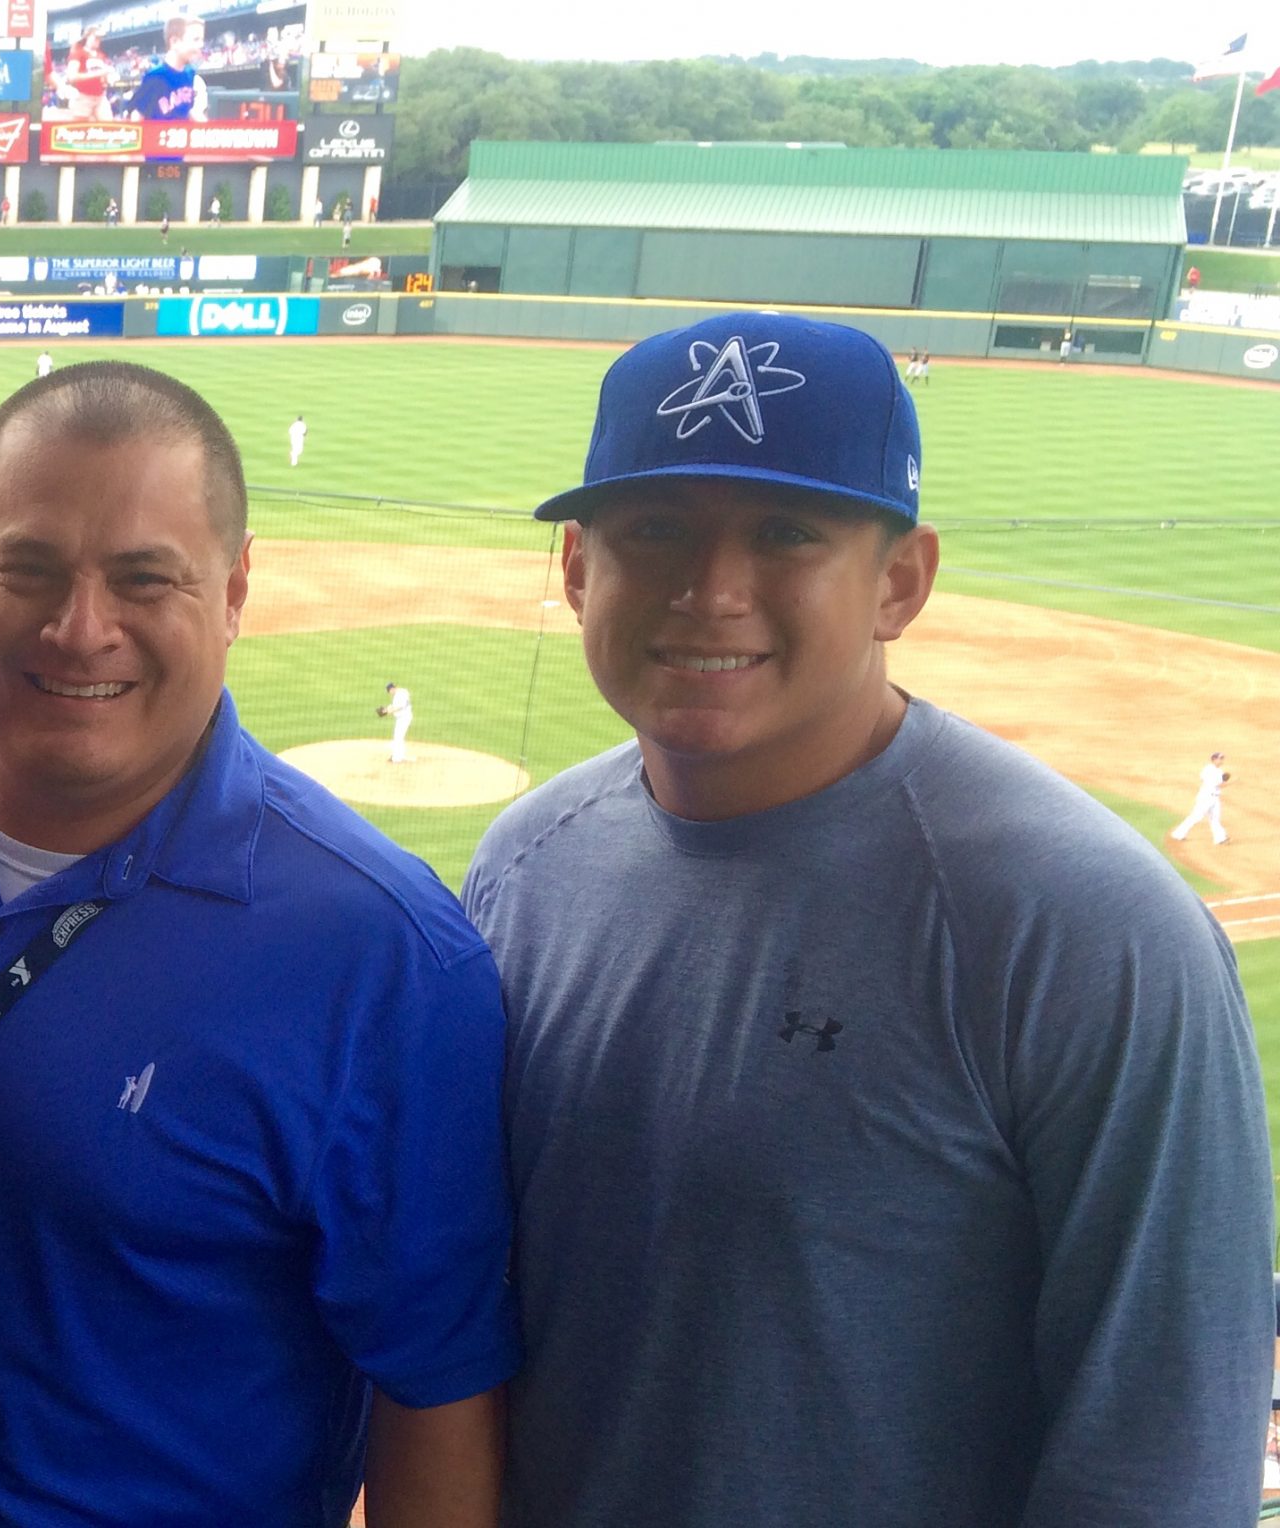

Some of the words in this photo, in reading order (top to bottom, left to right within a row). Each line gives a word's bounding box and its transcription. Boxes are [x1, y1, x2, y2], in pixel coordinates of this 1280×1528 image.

[190, 128, 279, 148] SHOWDOWN
[320, 138, 375, 148] LEXUS
[331, 148, 385, 158] AUSTIN
[52, 258, 70, 268] THE
[73, 258, 119, 268] SUPERIOR
[121, 258, 150, 268] LIGHT
[152, 258, 175, 268] BEER
[201, 302, 276, 331] DELL
[28, 319, 41, 333] in
[43, 319, 89, 336] August
[55, 904, 97, 945] EXPRESS
